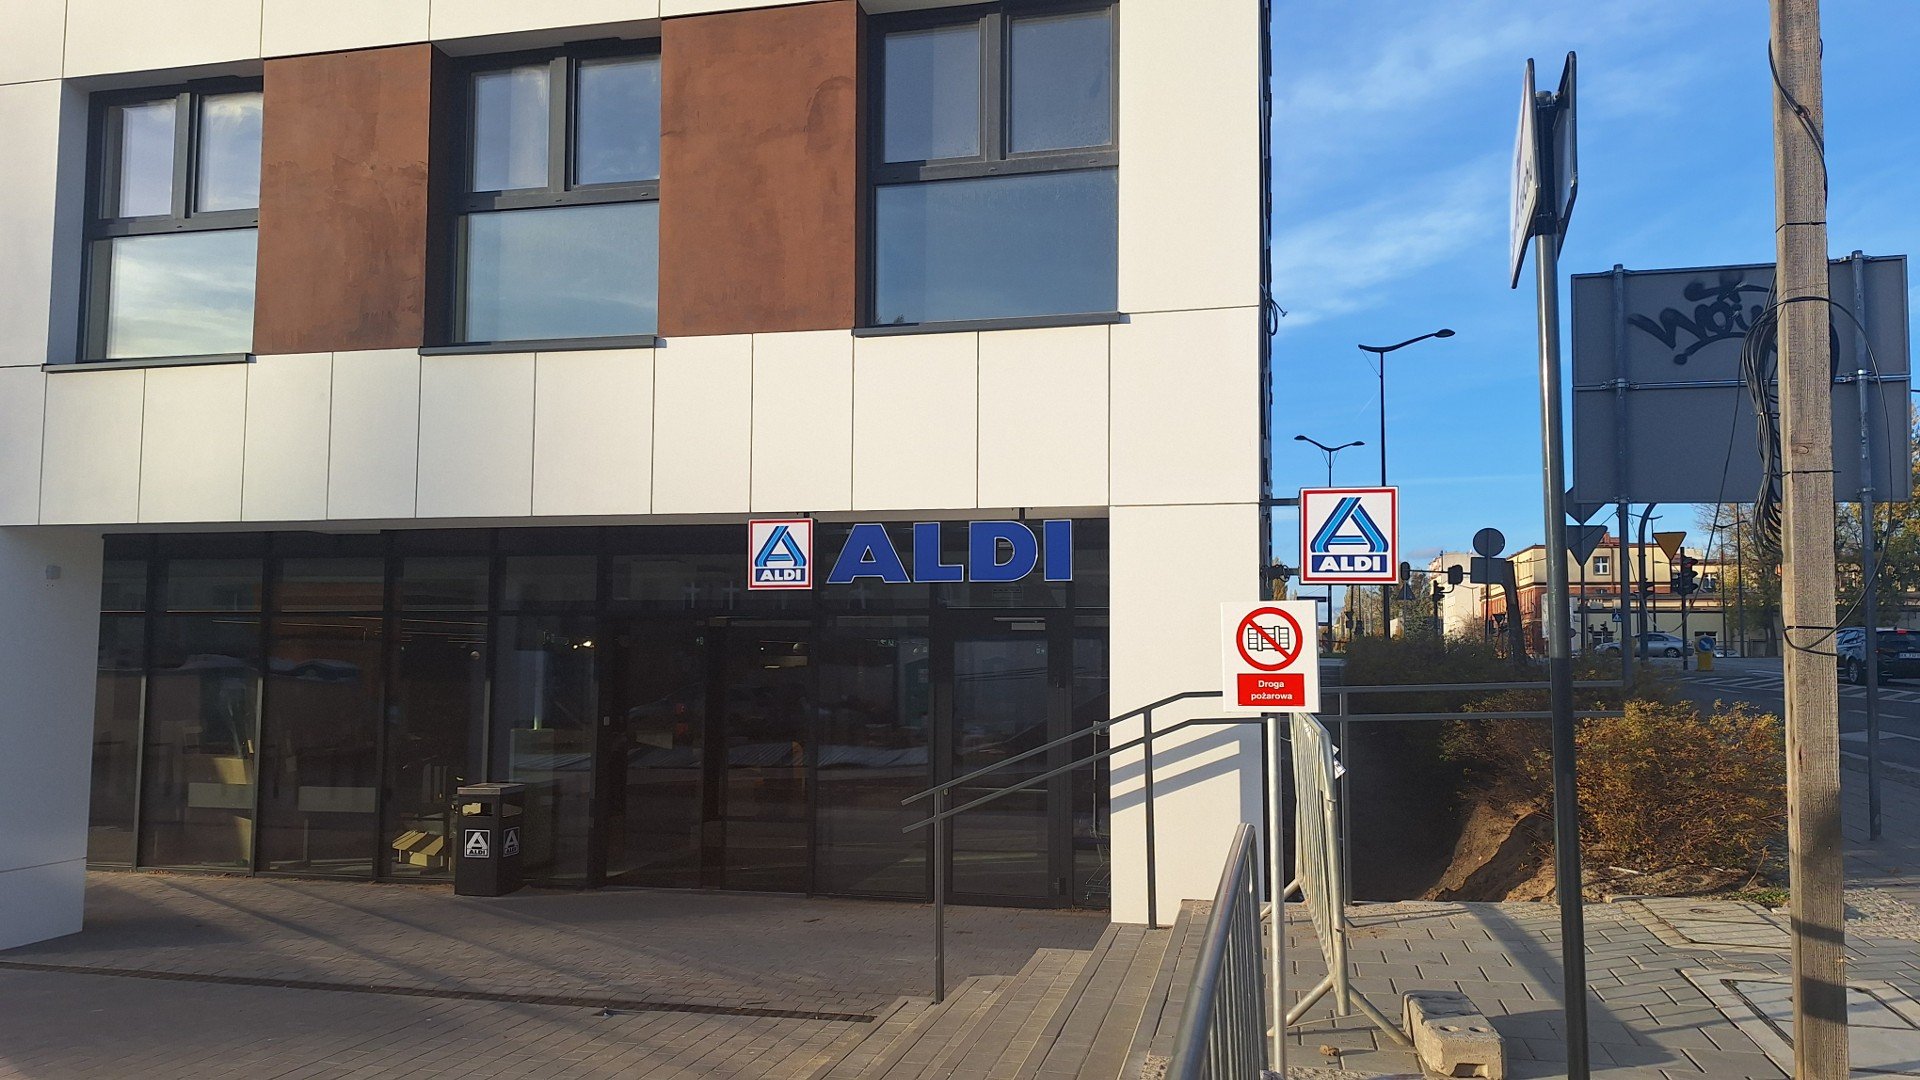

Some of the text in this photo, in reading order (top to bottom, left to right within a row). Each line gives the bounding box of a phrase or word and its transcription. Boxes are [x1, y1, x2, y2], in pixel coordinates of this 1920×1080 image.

[826, 519, 1073, 584] ALDI
[1318, 556, 1381, 571] ALDI
[760, 569, 802, 581] ALDI
[1258, 680, 1285, 690] Droga
[1251, 692, 1293, 701] pożarowa
